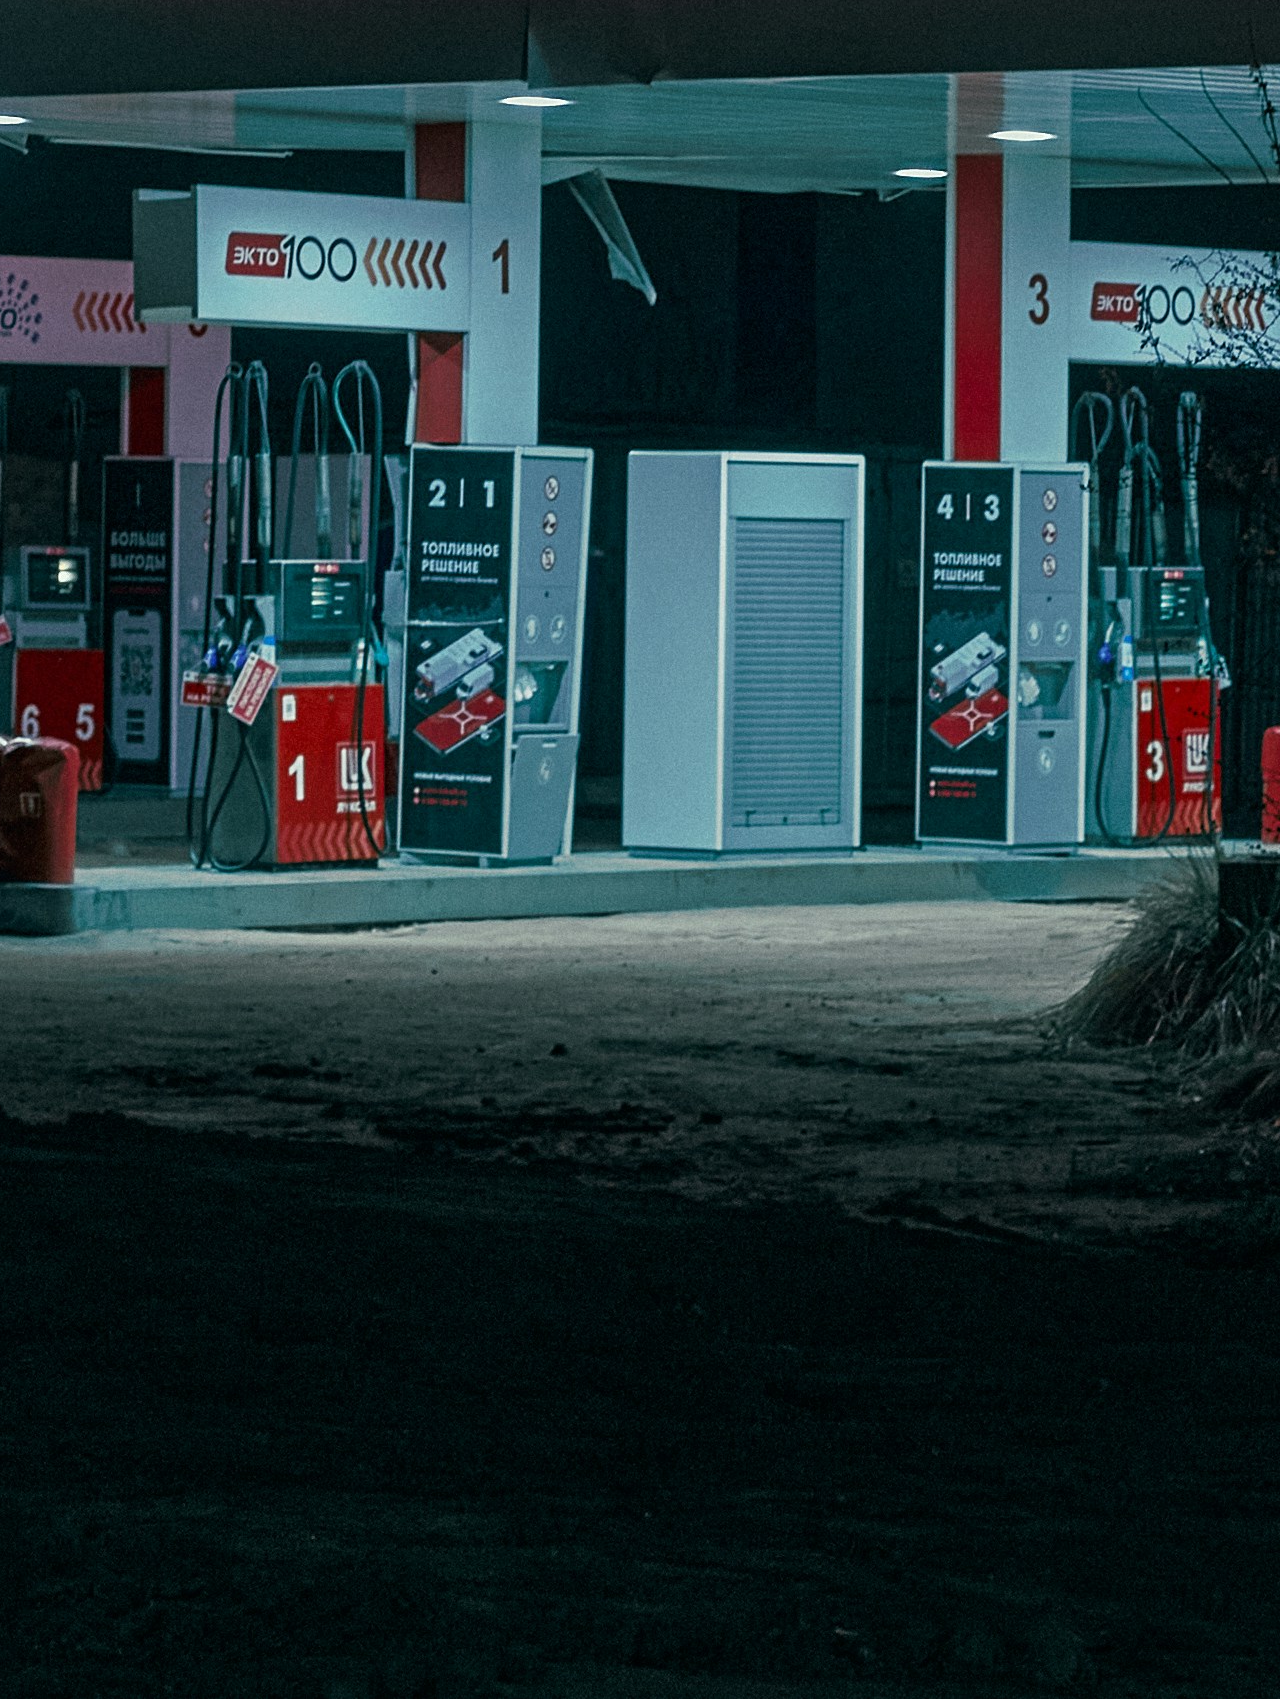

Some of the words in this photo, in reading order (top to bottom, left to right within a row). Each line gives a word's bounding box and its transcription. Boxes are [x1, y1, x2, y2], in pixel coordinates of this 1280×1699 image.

[233, 246, 279, 266] ЭКТО
[280, 235, 357, 282] 100
[492, 239, 509, 294] 1
[1029, 273, 1050, 325] 3
[1096, 295, 1134, 313] ЭКТО
[428, 478, 447, 508] 2
[483, 479, 495, 508] 1
[936, 493, 954, 520] 4
[984, 494, 1000, 521] 3
[110, 531, 167, 548] БОЛЬШЕ
[422, 541, 500, 558] ТОПЛИВНОЕ
[109, 553, 167, 572] ВЫГОДЫ
[421, 559, 480, 574] РЕШЕНИЕ
[933, 552, 1002, 567] ТОПЛИВНОЕ
[933, 568, 985, 583] РЕШЕНИЕ
[22, 704, 40, 738] 6
[76, 703, 95, 741] 5
[1146, 740, 1164, 782] 3
[288, 755, 305, 801] 1
